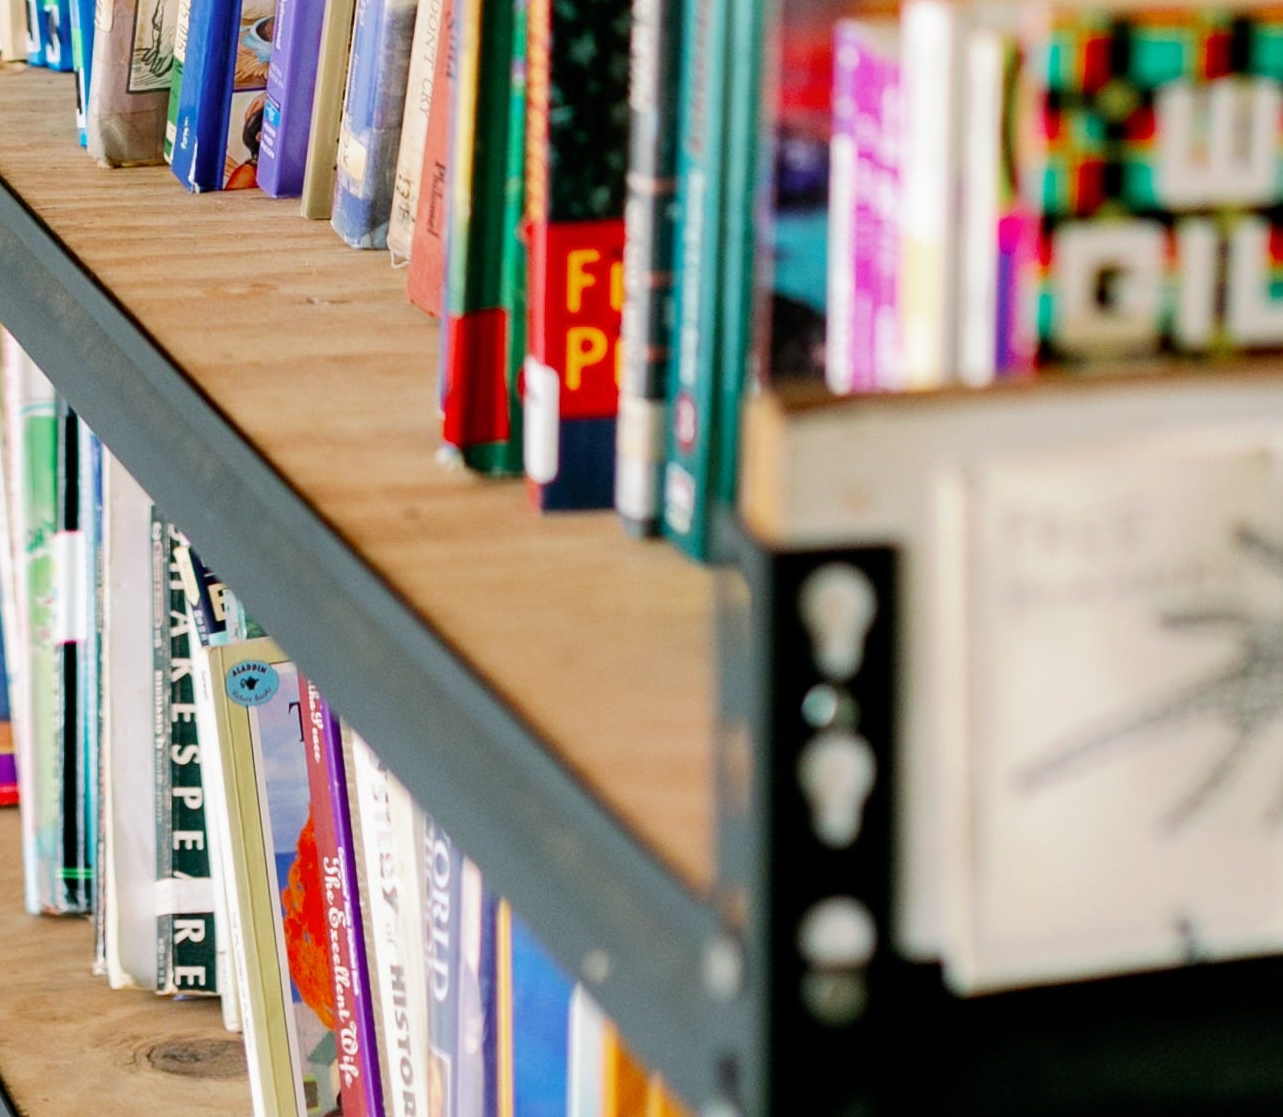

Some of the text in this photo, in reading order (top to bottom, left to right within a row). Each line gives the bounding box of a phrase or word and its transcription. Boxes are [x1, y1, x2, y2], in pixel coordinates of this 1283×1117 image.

[419, 76, 435, 119] CRY
[232, 663, 267, 677] ALADDIN
[322, 856, 343, 904] The
[432, 823, 450, 1002] ORLD
[328, 905, 350, 1019] Excellent
[338, 1021, 359, 1087] Wife
